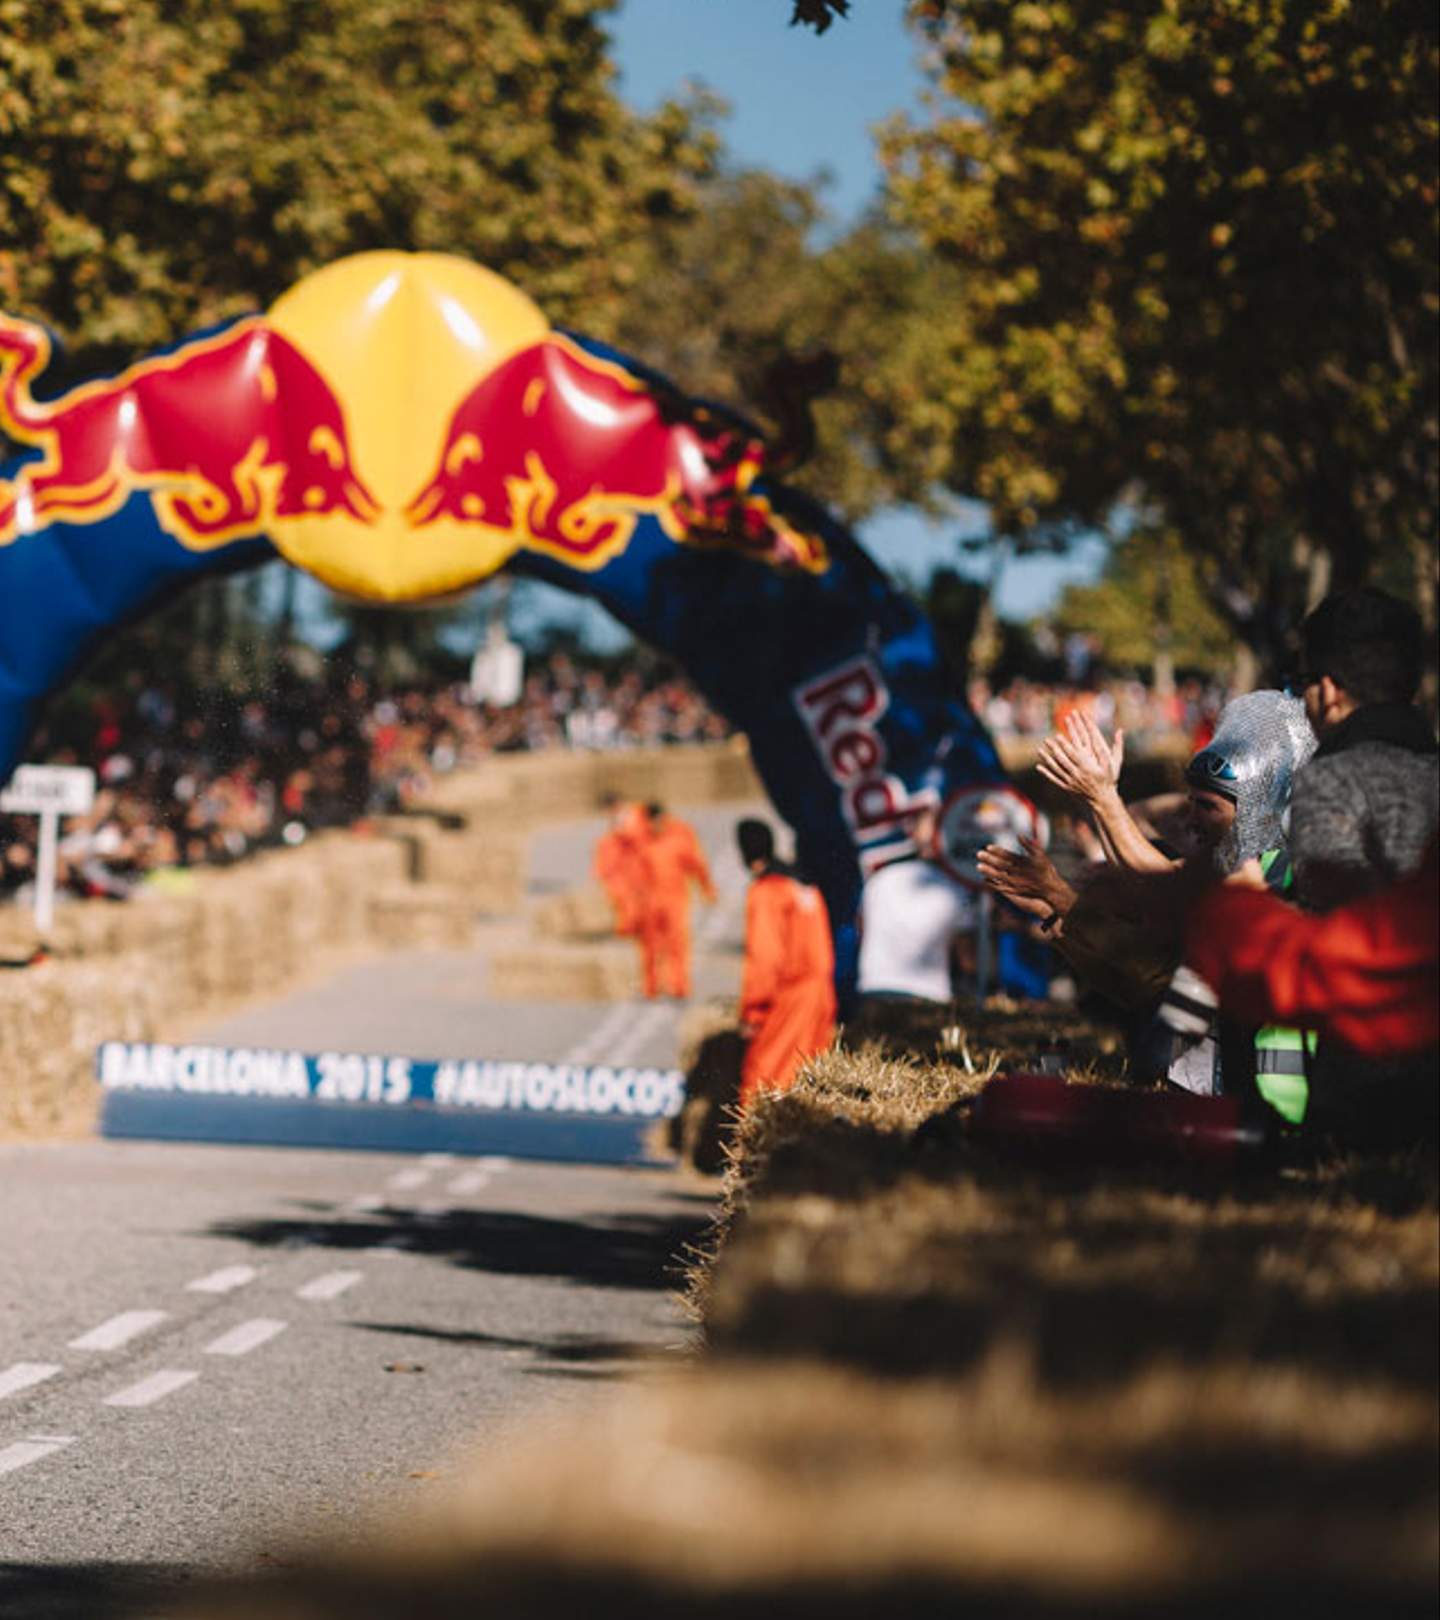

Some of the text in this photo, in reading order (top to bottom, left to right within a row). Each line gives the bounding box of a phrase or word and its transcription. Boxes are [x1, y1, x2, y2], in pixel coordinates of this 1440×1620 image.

[803, 666, 929, 829] Red
[101, 1042, 685, 1118] BARCELONA 2015 #AUTOSLOCOS
